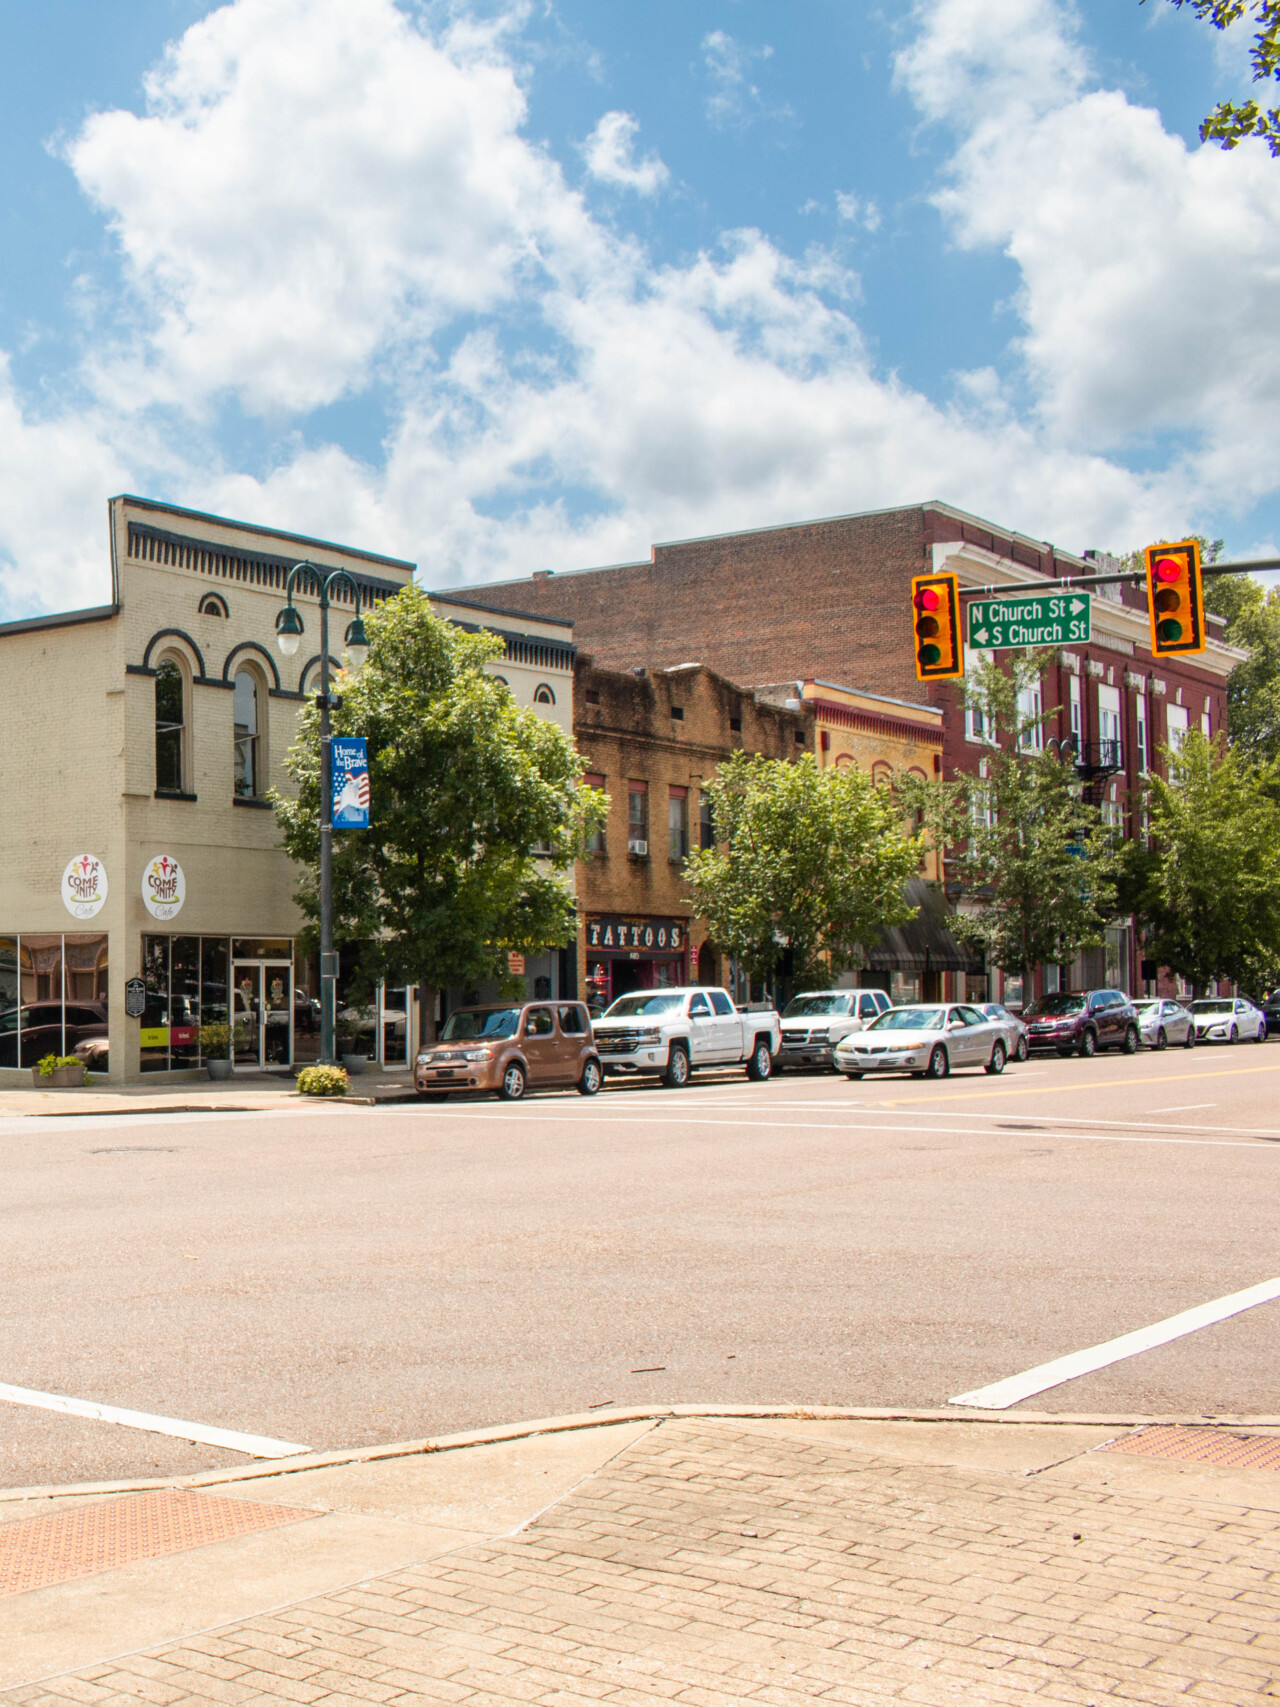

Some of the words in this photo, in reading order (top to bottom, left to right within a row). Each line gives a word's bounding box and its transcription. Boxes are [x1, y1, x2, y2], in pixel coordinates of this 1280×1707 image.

[972, 605, 983, 624] N
[989, 601, 1042, 622] Church
[1048, 599, 1066, 618] St
[992, 626, 1003, 645] S
[1009, 622, 1062, 643] Church
[1069, 620, 1086, 639] St
[334, 745, 356, 758] Home
[356, 748, 364, 759] of
[335, 758, 344, 766] the
[344, 756, 368, 770] Brave
[67, 875, 99, 889] COME
[148, 875, 178, 888] COME
[591, 924, 680, 947] TATTOOS
